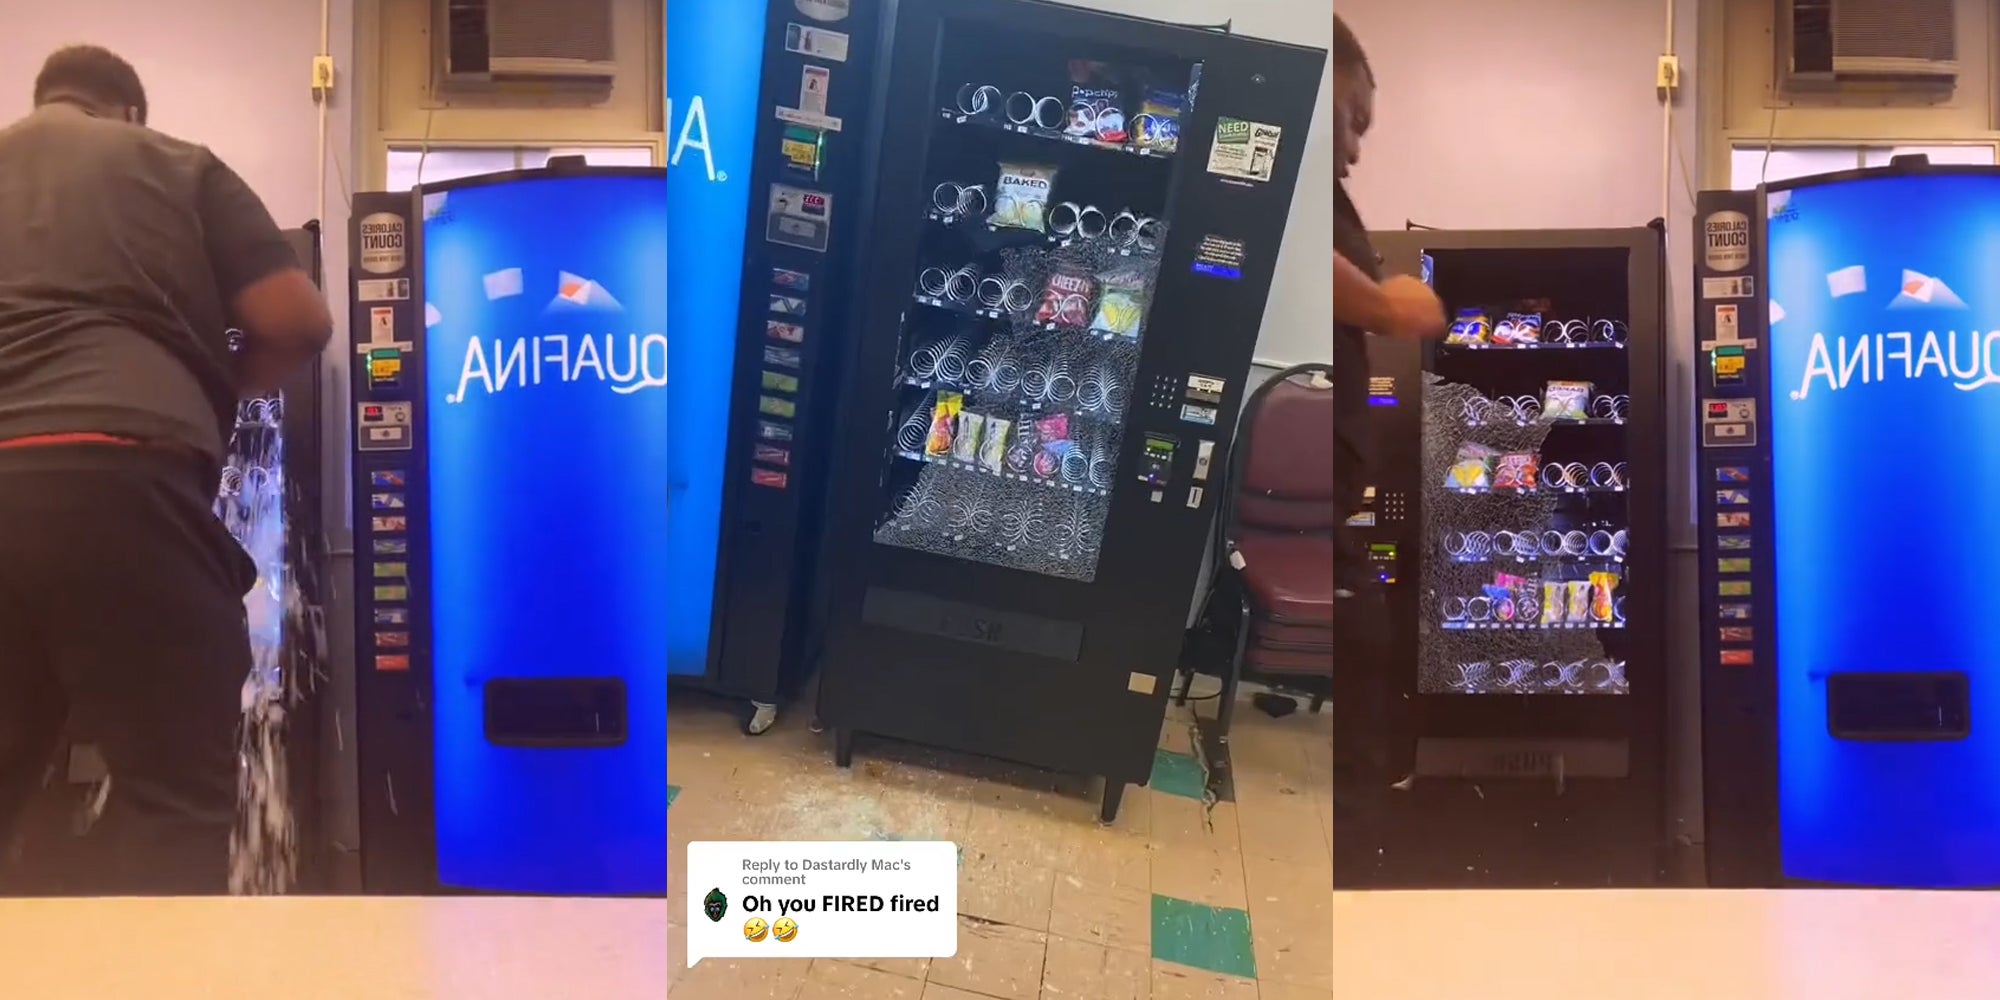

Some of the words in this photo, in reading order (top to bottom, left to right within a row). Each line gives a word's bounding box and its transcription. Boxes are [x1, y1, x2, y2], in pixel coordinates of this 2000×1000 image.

[1218, 121, 1249, 134] NEED
[667, 95, 716, 182] A
[1003, 176, 1048, 189] BAKED
